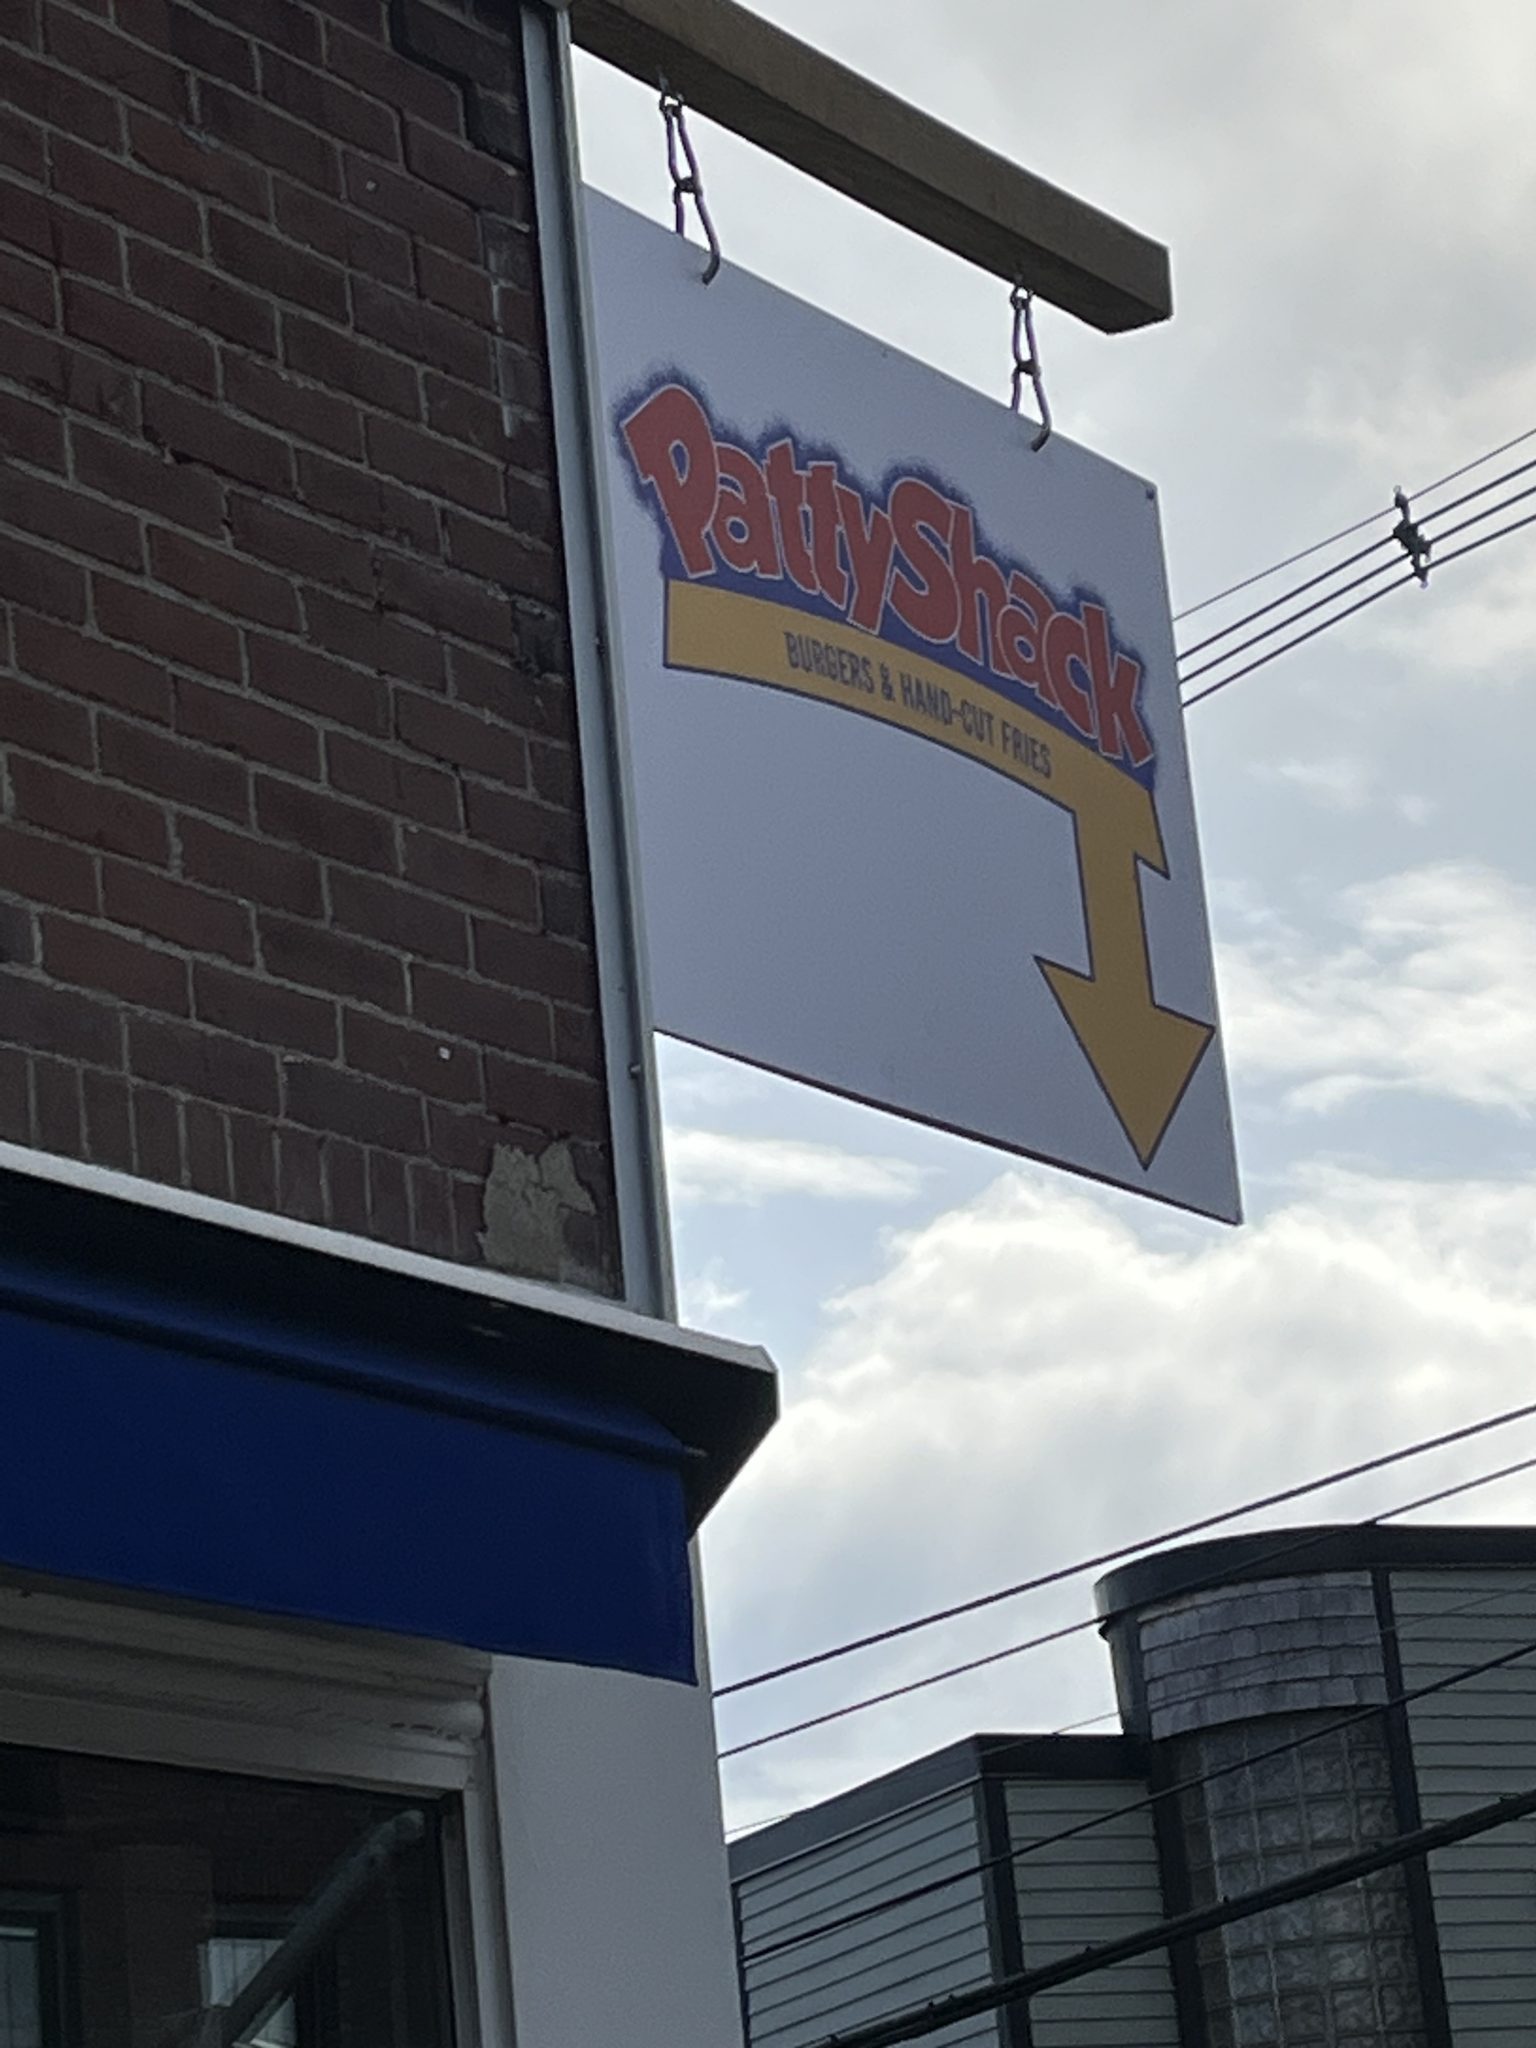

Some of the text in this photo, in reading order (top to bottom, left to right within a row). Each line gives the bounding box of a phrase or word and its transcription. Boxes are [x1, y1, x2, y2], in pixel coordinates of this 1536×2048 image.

[620, 383, 1154, 767] PattyShack
[783, 630, 1052, 780] BURGERS & HAND-CUT FRIES
